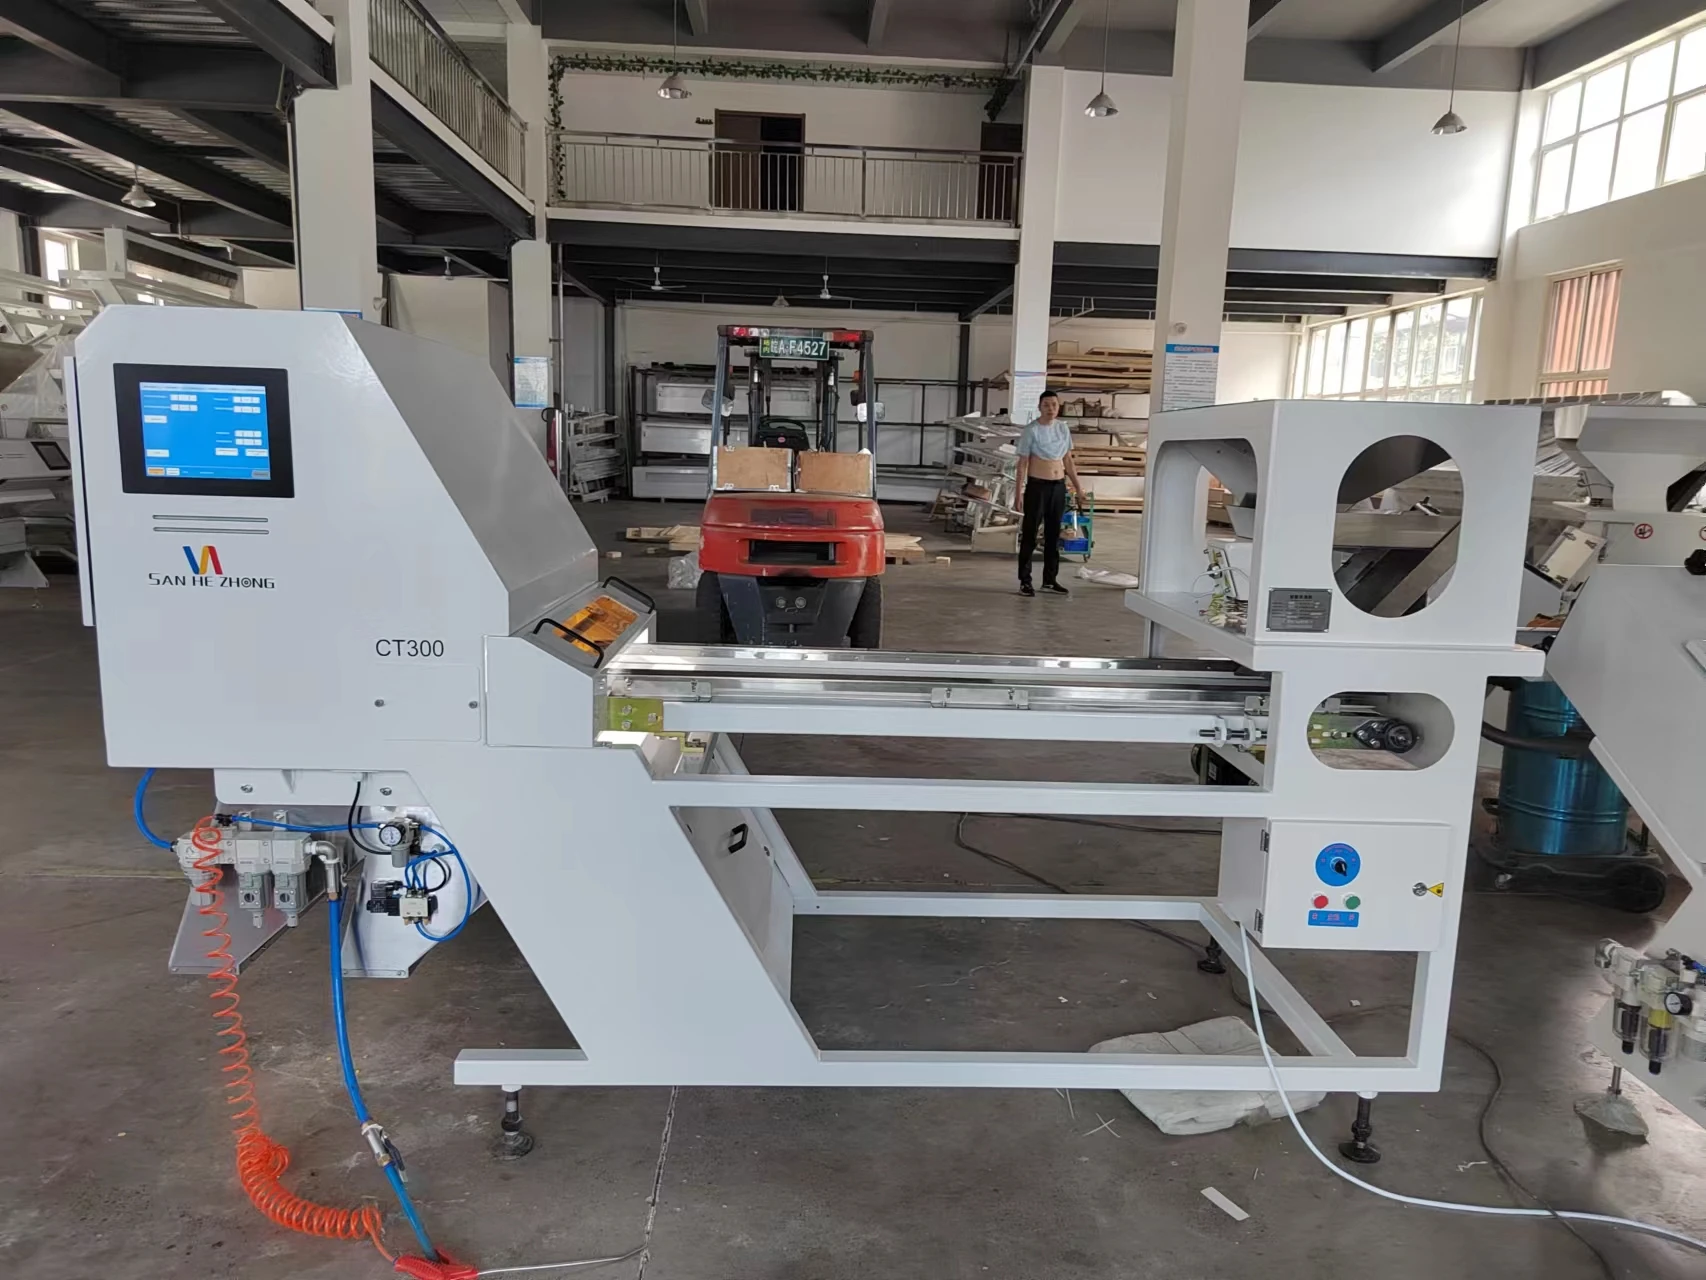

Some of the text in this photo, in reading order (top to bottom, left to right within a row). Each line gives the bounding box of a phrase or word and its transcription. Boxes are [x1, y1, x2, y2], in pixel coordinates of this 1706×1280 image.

[148, 572, 276, 589] SAN HE ZHONG
[375, 639, 444, 657] CT300
